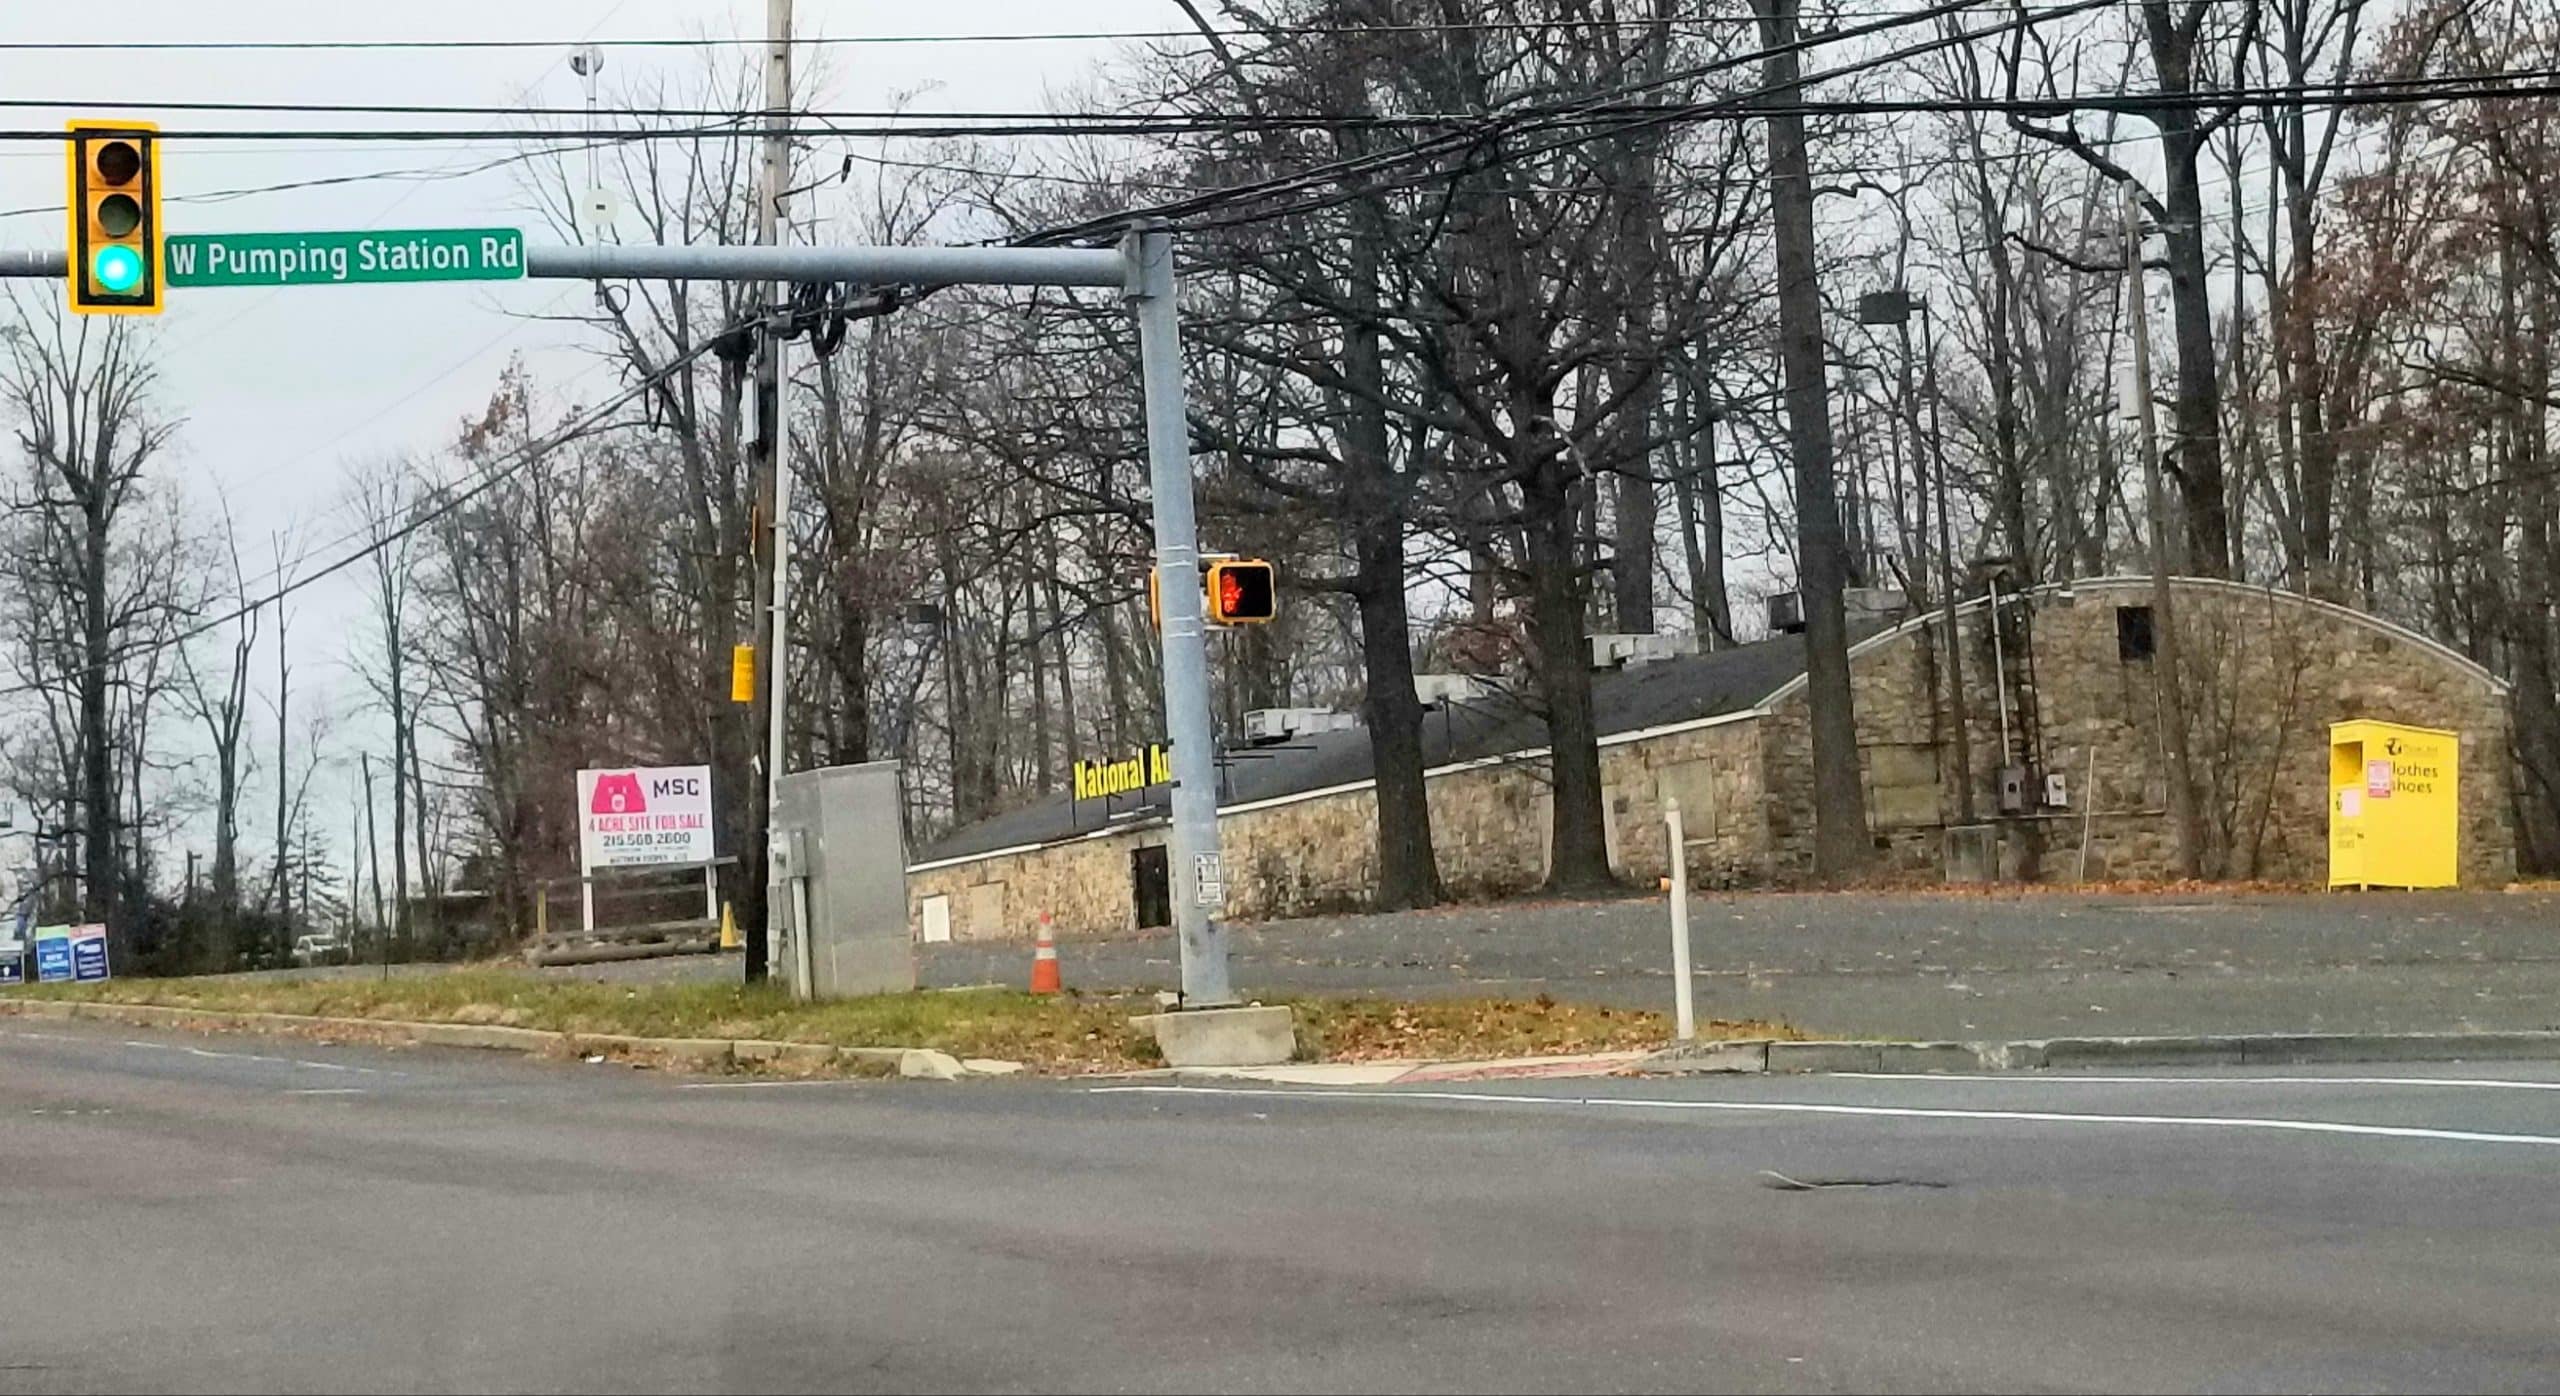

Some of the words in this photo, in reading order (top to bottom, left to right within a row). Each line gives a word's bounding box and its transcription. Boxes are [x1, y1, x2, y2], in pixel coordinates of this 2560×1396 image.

[171, 244, 197, 275] W
[208, 242, 348, 280] Pumping
[358, 239, 470, 271] Station
[480, 236, 519, 268] Rd
[1074, 747, 1146, 801] National
[2391, 760, 2439, 778] lothes
[653, 778, 699, 798] MSC
[599, 815, 625, 832] ACRE
[628, 814, 651, 831] SITE
[655, 813, 676, 830] FOR
[679, 813, 704, 829] SALE
